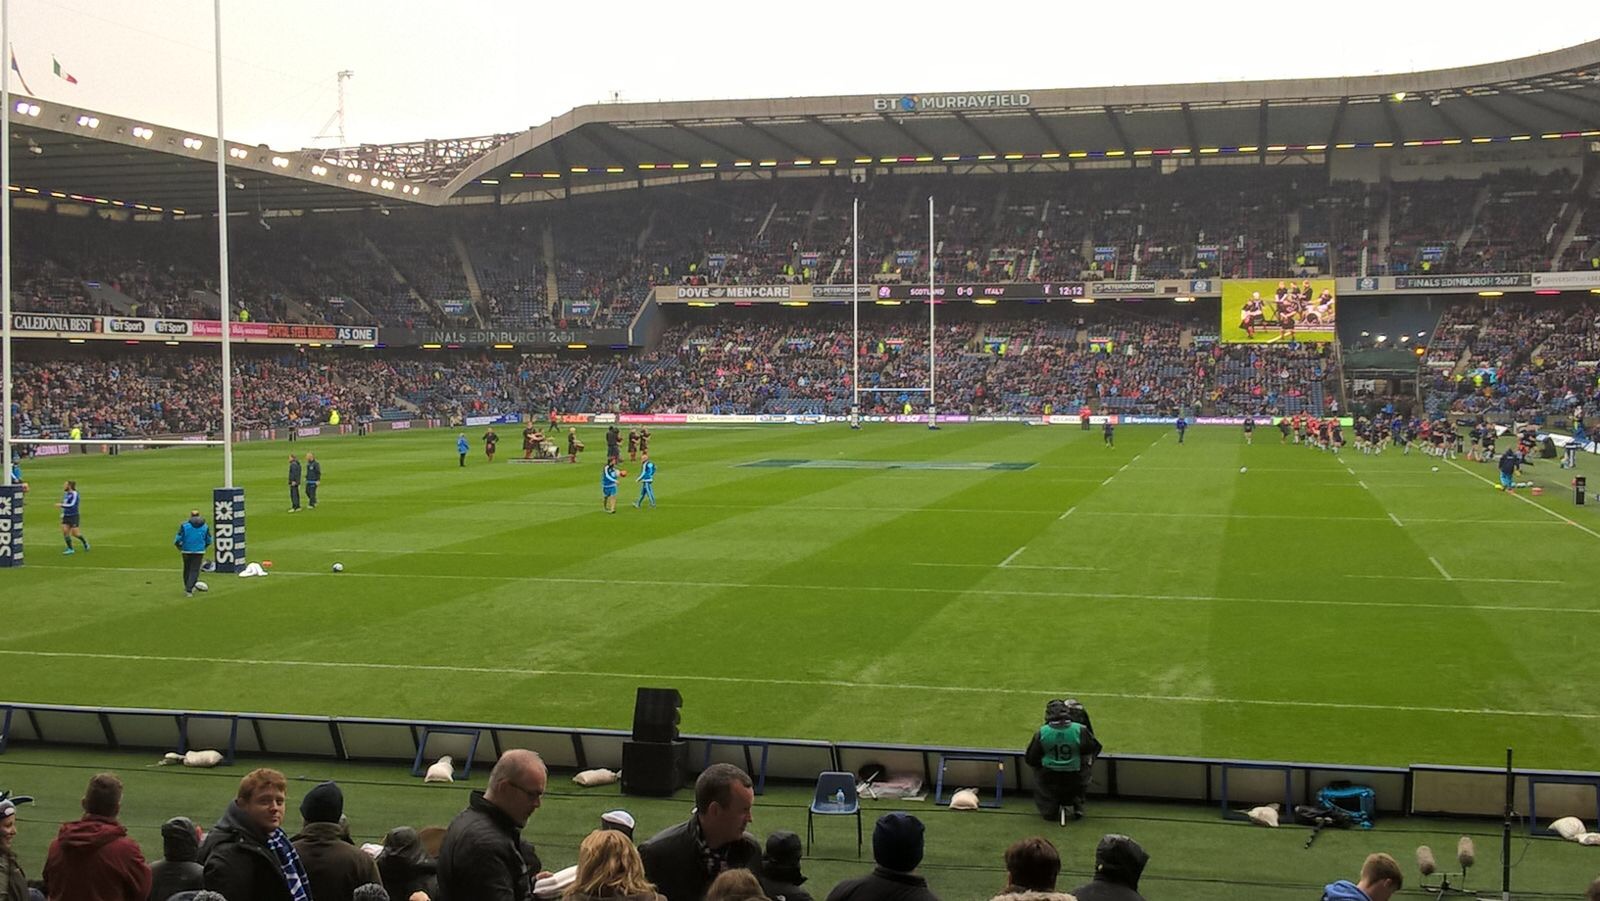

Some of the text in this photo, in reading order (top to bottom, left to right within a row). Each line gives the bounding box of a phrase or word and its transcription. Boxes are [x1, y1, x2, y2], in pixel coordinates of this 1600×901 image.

[874, 94, 1030, 110] BT MURRAYFIELD
[1408, 278, 1440, 287] FINALS
[1441, 277, 1494, 287] EDINBURGH
[678, 287, 790, 298] DOVE MEN+CARE
[984, 288, 1004, 296] ITALY
[1059, 287, 1083, 296] 12:12
[14, 316, 93, 331] CALEDONIA BEST
[113, 321, 143, 332] BT Sport
[158, 322, 168, 332] BT
[168, 322, 186, 333] Sport
[338, 328, 373, 340] AS ONE
[422, 331, 466, 343] FINALS
[469, 331, 546, 343] EDINBURGH
[216, 524, 235, 564] RBS
[1049, 743, 1073, 761] 19
